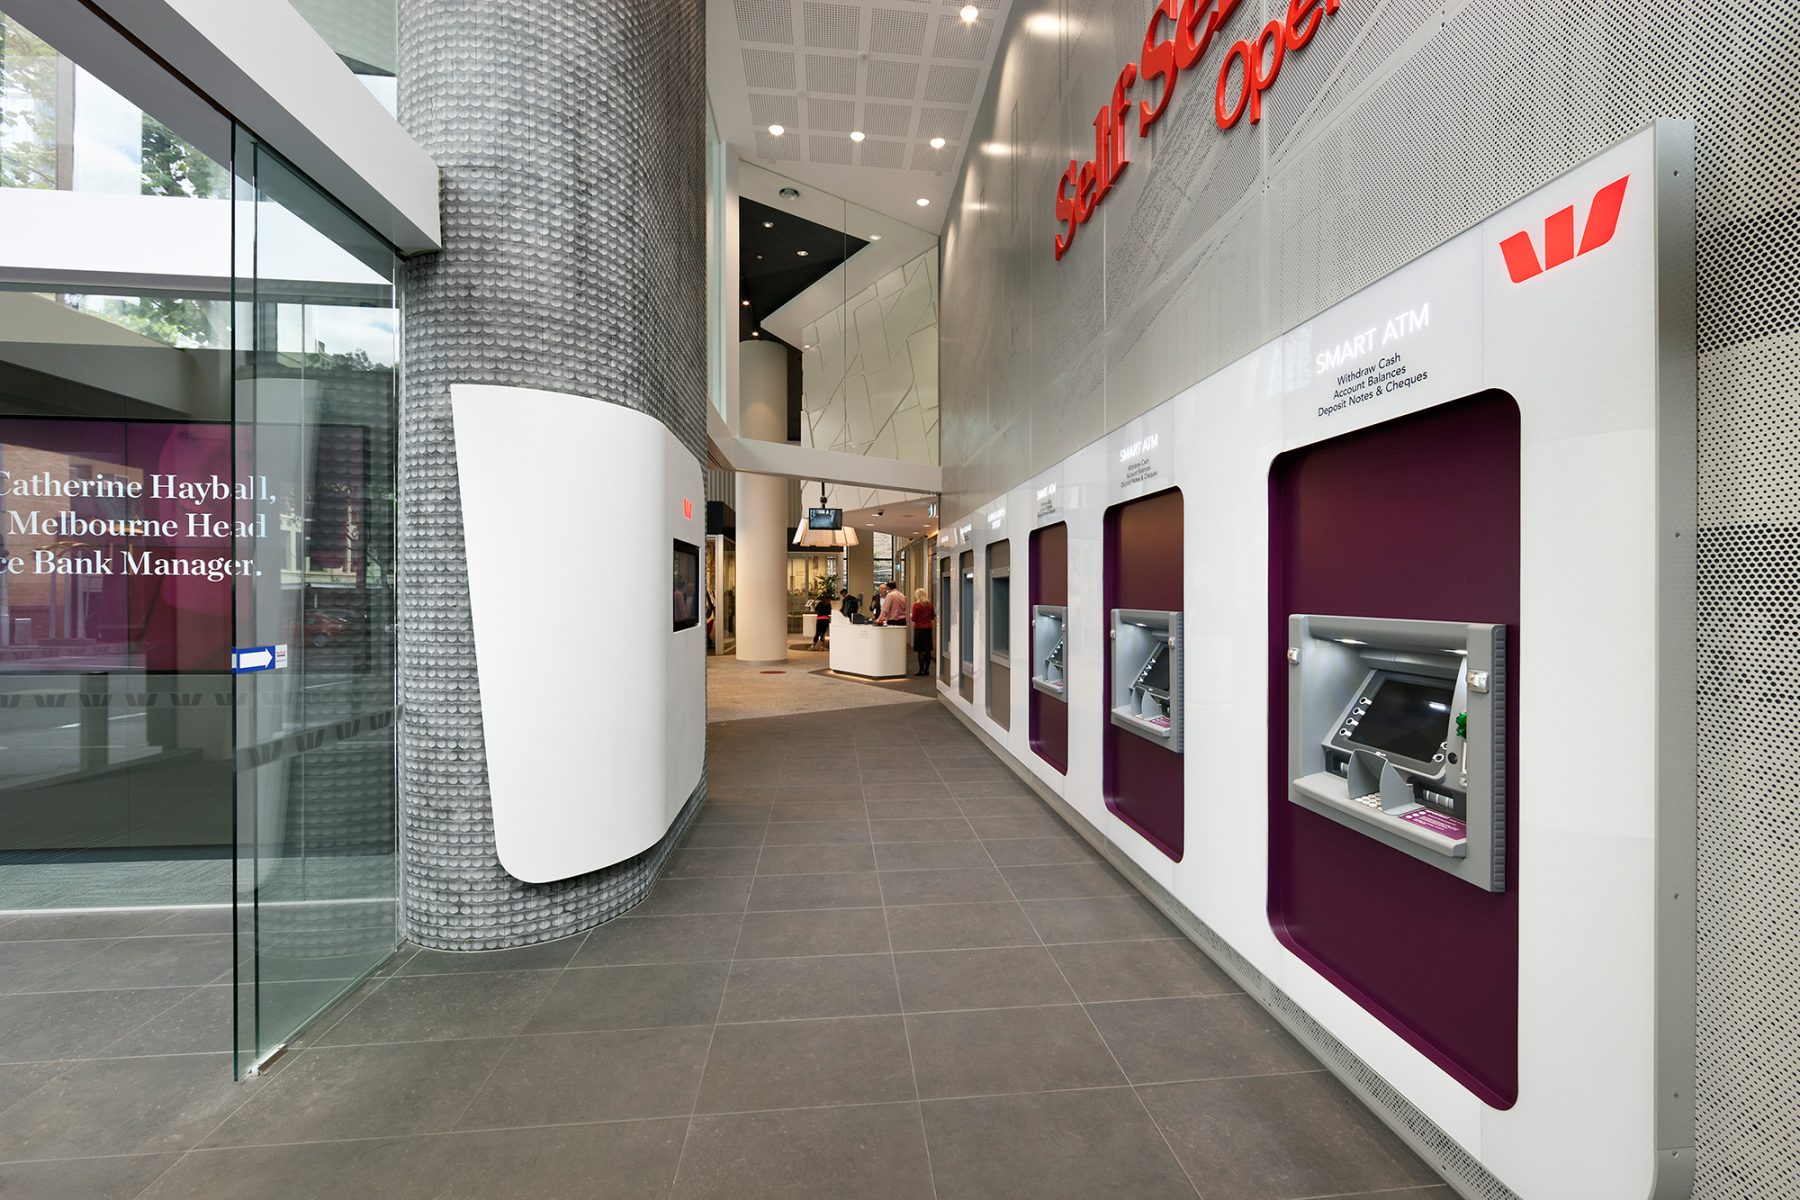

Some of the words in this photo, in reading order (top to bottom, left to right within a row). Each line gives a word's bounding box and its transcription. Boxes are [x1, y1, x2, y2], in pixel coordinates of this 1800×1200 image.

[1215, 0, 1340, 129] Ope
[1055, 63, 1137, 260] Self
[1140, 0, 1243, 137] Se
[1315, 326, 1378, 375] SMART
[1381, 301, 1430, 346] ATM
[1333, 381, 1366, 400] Account
[1367, 365, 1407, 387] Balances
[1336, 363, 1377, 387] Withdraw
[1378, 352, 1402, 370] Cash
[1317, 399, 1347, 417] Deposit
[1348, 391, 1374, 406] Notes
[1375, 385, 1384, 397] &
[1385, 371, 1429, 393] Cheques
[149, 474, 277, 506] Hayball,
[7, 510, 179, 537] Melbourne
[185, 513, 268, 538] Head
[32, 550, 114, 576] Bank
[120, 551, 263, 582] Manager.
